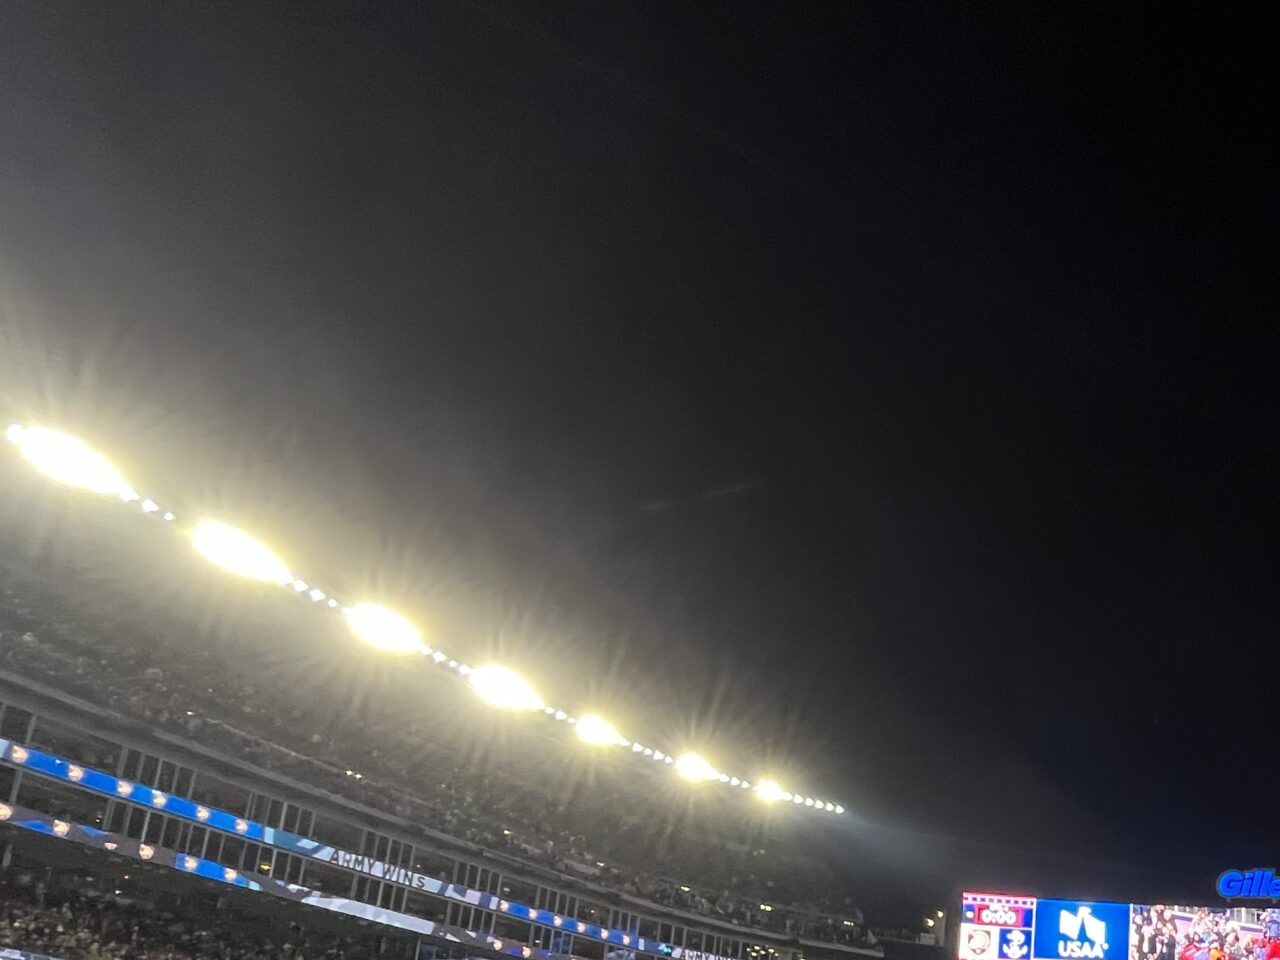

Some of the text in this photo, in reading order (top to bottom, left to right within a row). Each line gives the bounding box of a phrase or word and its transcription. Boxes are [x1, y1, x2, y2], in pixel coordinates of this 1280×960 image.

[331, 849, 425, 888] ARMY WINS
[981, 908, 1017, 925] 0:00
[1058, 940, 1105, 959] USAA
